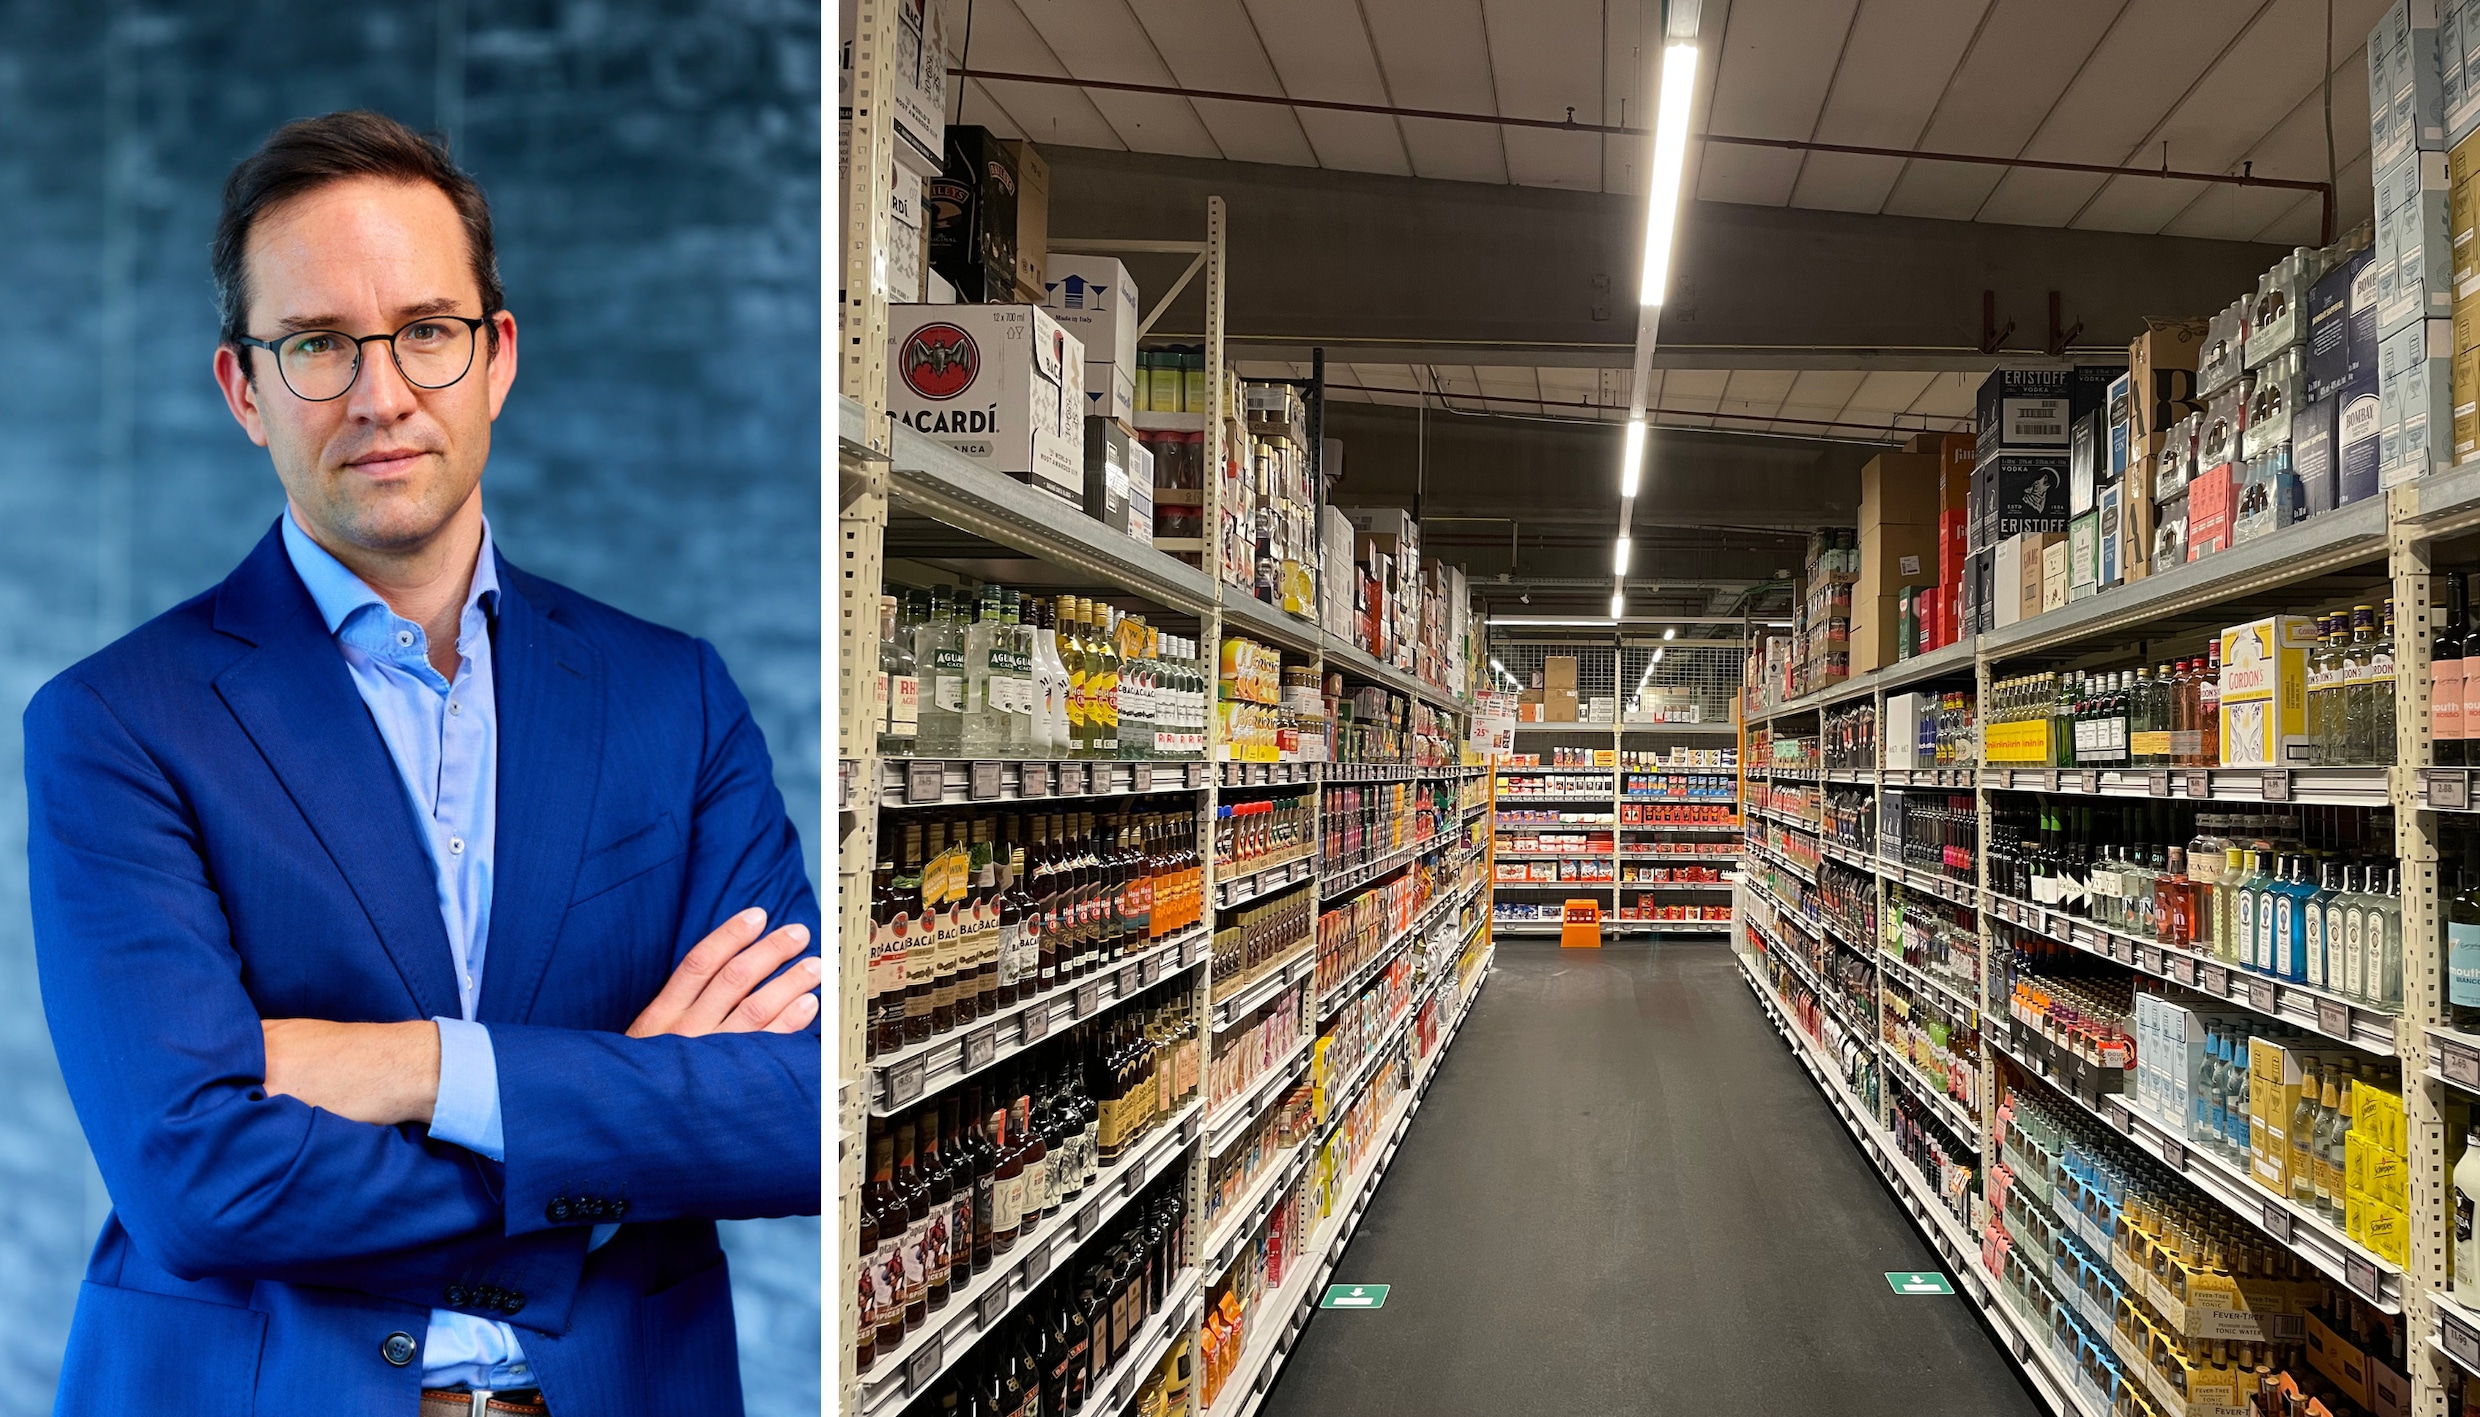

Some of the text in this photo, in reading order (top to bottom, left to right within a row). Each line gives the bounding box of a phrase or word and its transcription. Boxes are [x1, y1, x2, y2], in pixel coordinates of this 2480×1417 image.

[1056, 314, 1071, 322] Made
[2005, 371, 2068, 385] ERISTOFF
[2346, 403, 2375, 431] BOMBAY
[2001, 518, 2067, 533] ERISTOFF
[2228, 669, 2264, 691] GORDON'S
[927, 864, 942, 880] WIN
[950, 864, 964, 875] WIN
[2194, 1291, 2230, 1300] FEVER-TREE
[2213, 1310, 2265, 1320] FEVER-TREE
[2240, 1328, 2263, 1336] WATER
[2195, 1387, 2230, 1395] FEVER-TREE
[2215, 1407, 2250, 1416] FEVER-T
